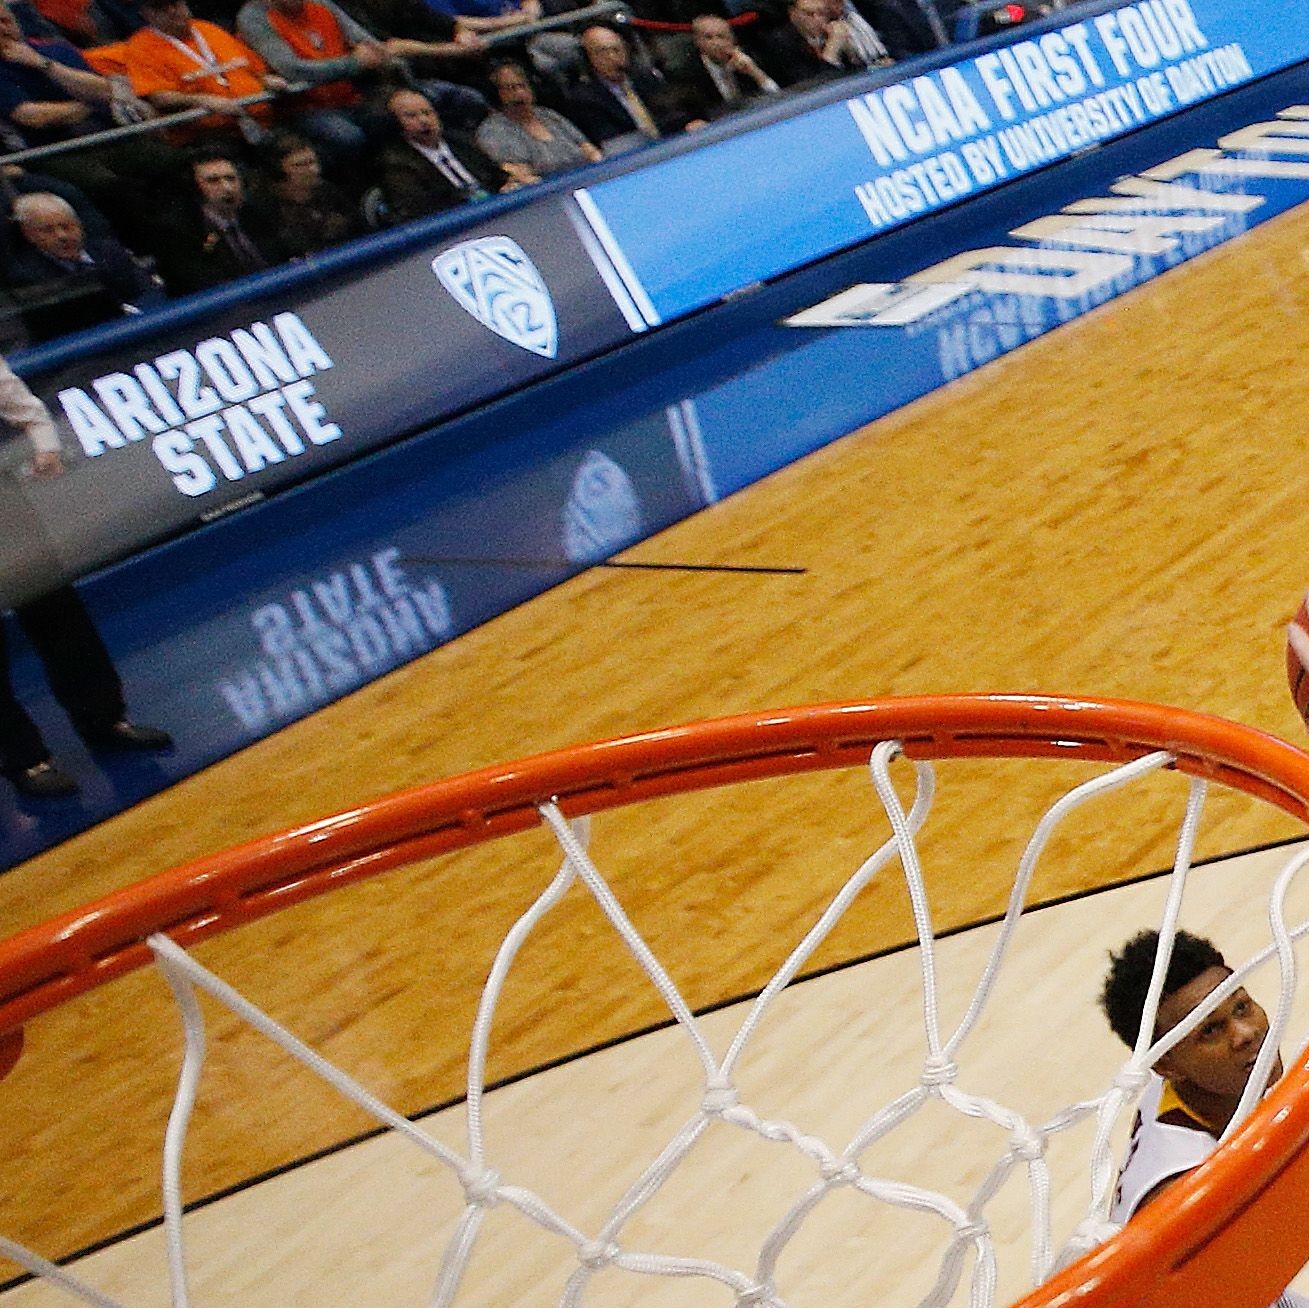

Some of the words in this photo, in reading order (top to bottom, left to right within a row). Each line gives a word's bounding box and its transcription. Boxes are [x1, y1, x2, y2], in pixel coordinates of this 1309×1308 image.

[846, 66, 991, 167] NCAA
[974, 23, 1106, 120] FIRST
[1094, 0, 1208, 78] FOUR
[854, 151, 974, 228] HOSTED
[960, 135, 1008, 185] BY
[998, 81, 1146, 171] UNIVERSITY
[1135, 71, 1173, 116] OF
[1163, 42, 1254, 105] DAYTON
[57, 310, 334, 457] ARIZONA
[151, 379, 344, 497] STATE
